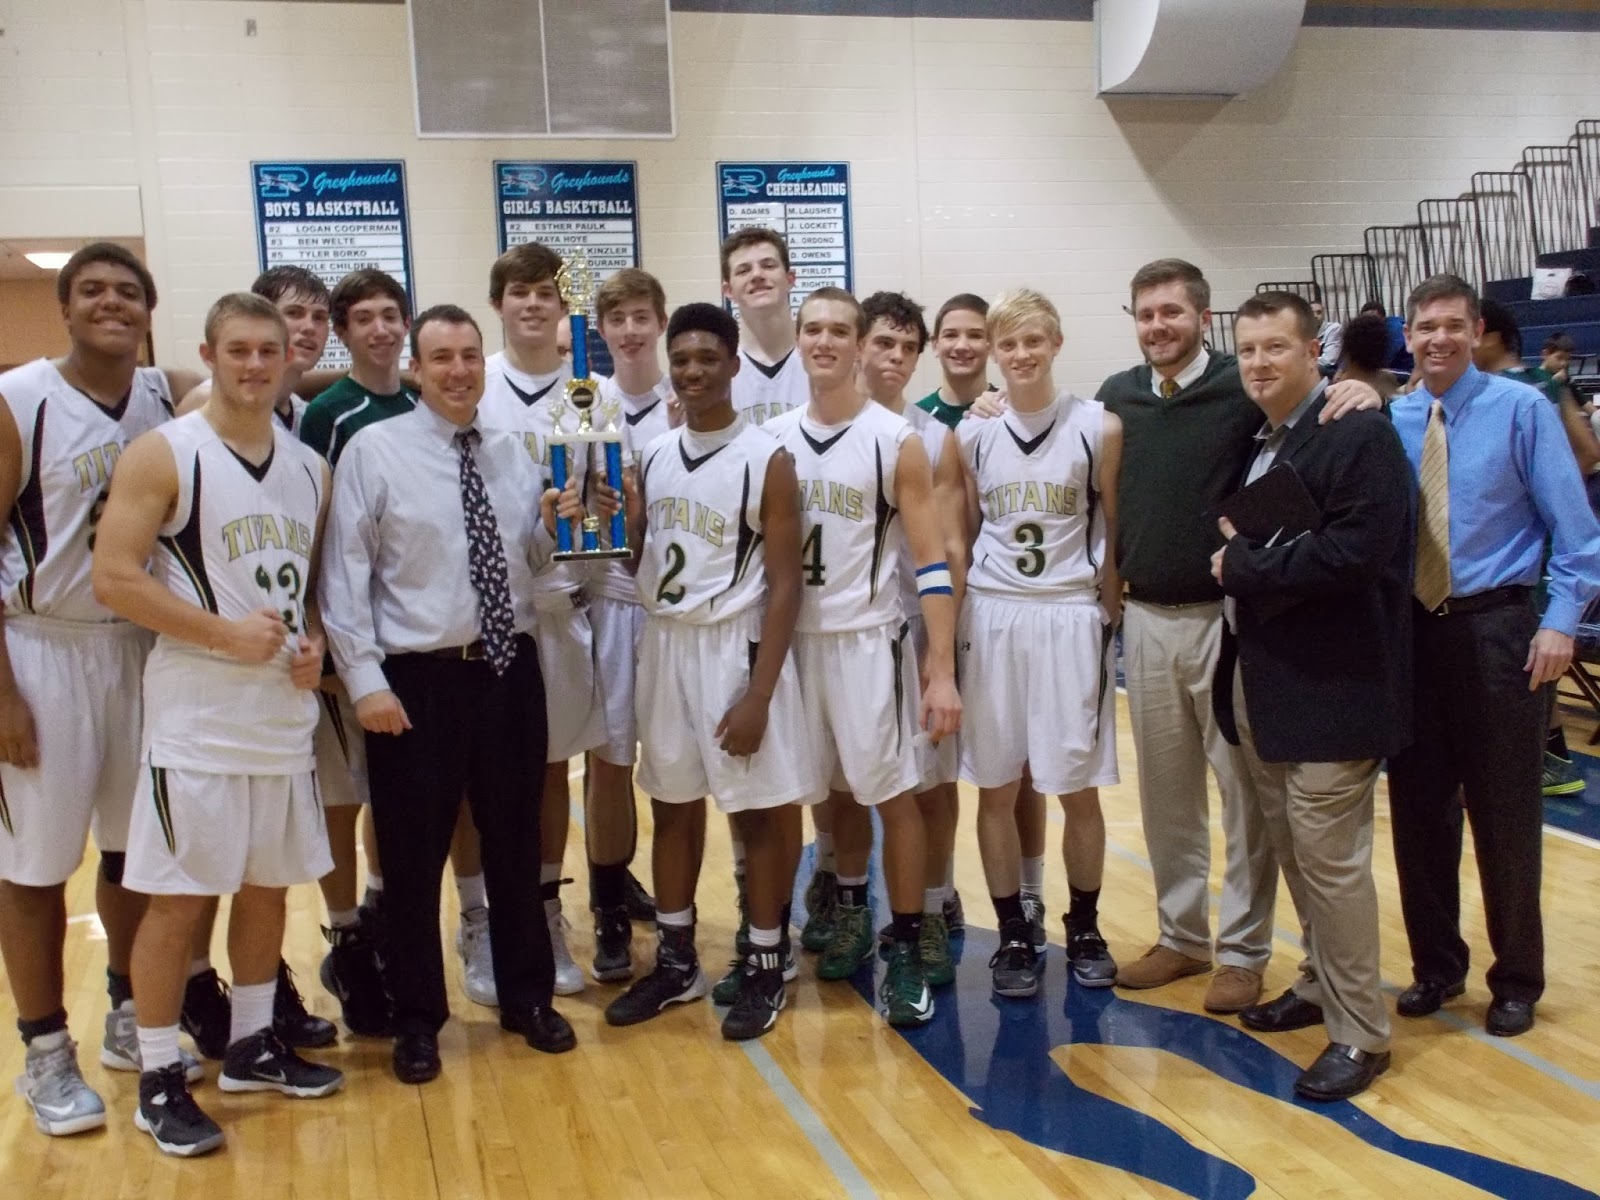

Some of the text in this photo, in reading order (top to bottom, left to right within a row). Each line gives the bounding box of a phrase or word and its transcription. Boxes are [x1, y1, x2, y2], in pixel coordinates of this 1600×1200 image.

[313, 168, 397, 196] Greyhounds
[551, 168, 630, 194] Greyhounds
[777, 166, 836, 183] Greyhounds
[766, 183, 847, 196] CHEERLEADING
[265, 201, 399, 217] BOYS BASKETBALL
[503, 200, 632, 214] GIRLS BASKETBALL
[587, 247, 628, 255] KINZLER
[330, 262, 380, 271] CHILDERS
[588, 259, 627, 267] DURAND
[985, 481, 1077, 522] TITANS
[222, 514, 313, 562] TITANS
[802, 524, 825, 586] 4
[1015, 523, 1045, 577] 3
[657, 542, 686, 604] 2
